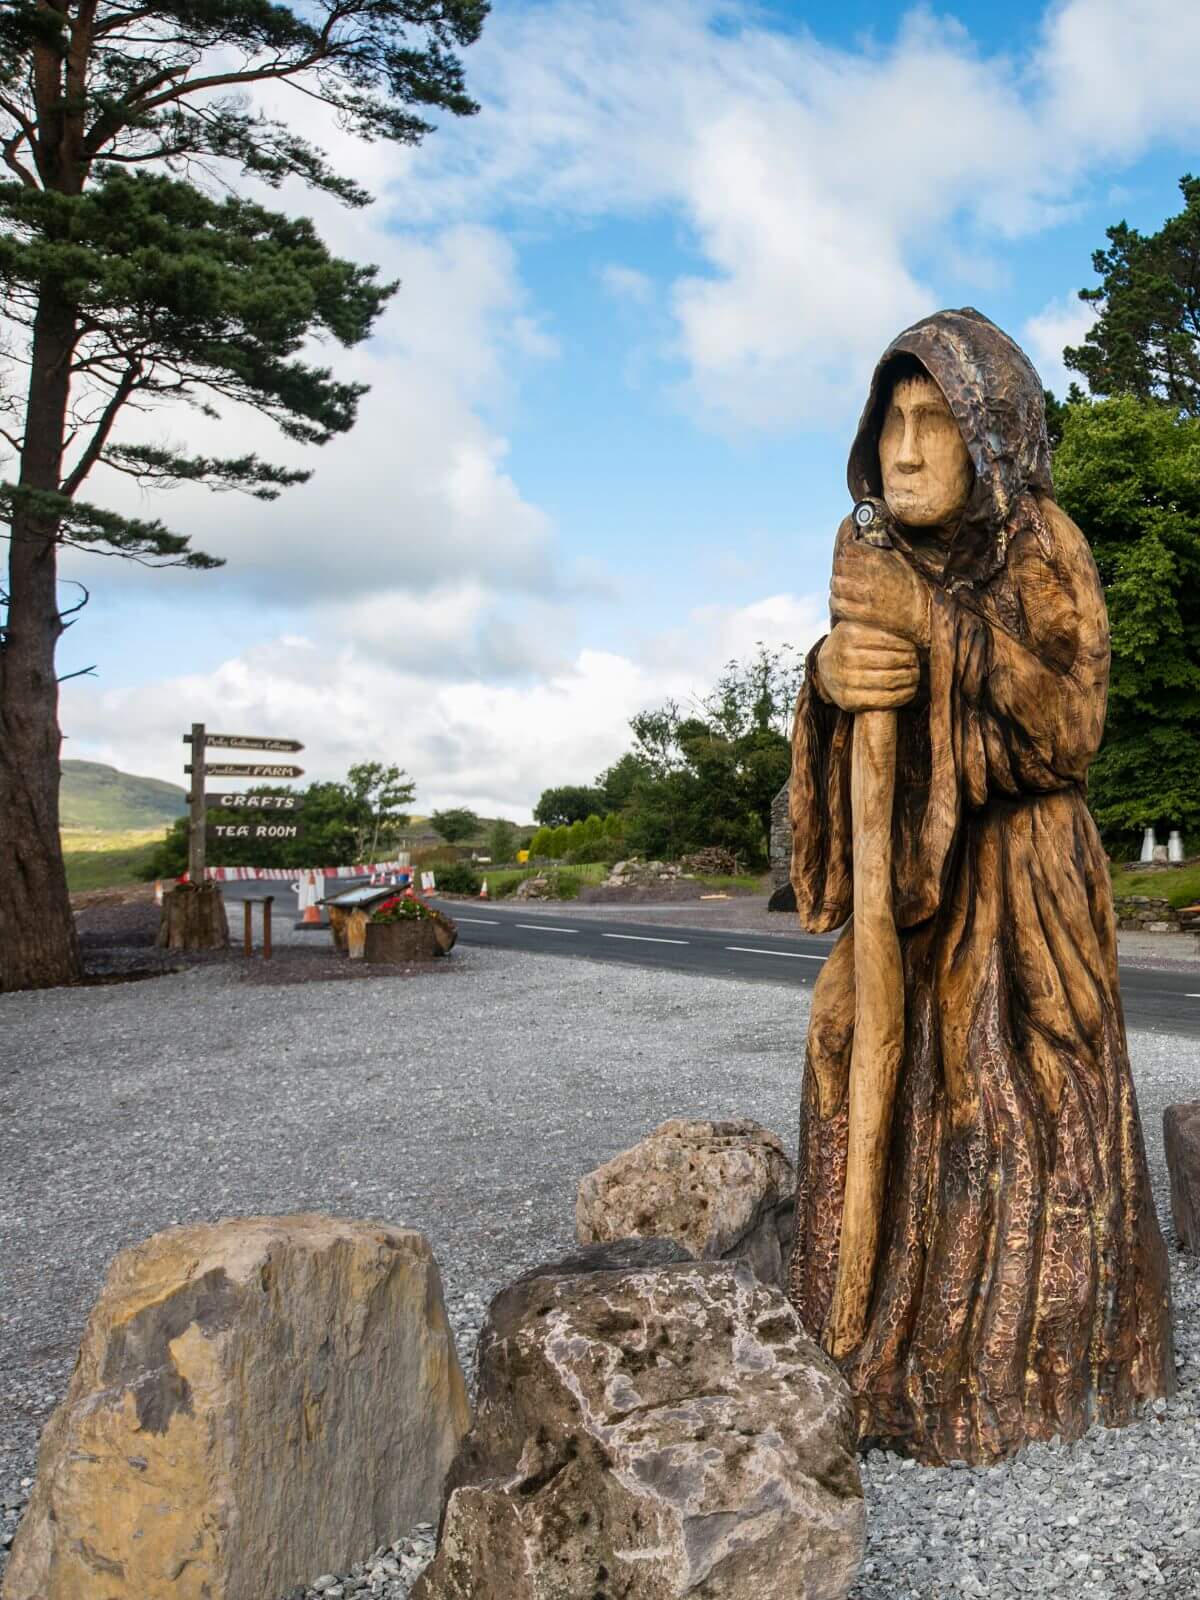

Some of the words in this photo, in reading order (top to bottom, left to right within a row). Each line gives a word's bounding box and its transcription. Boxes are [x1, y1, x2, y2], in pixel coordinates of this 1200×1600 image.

[253, 767, 294, 776] FARM
[221, 795, 295, 808] CRAFTS
[215, 825, 249, 837] TEA
[256, 826, 297, 838] ROOM
